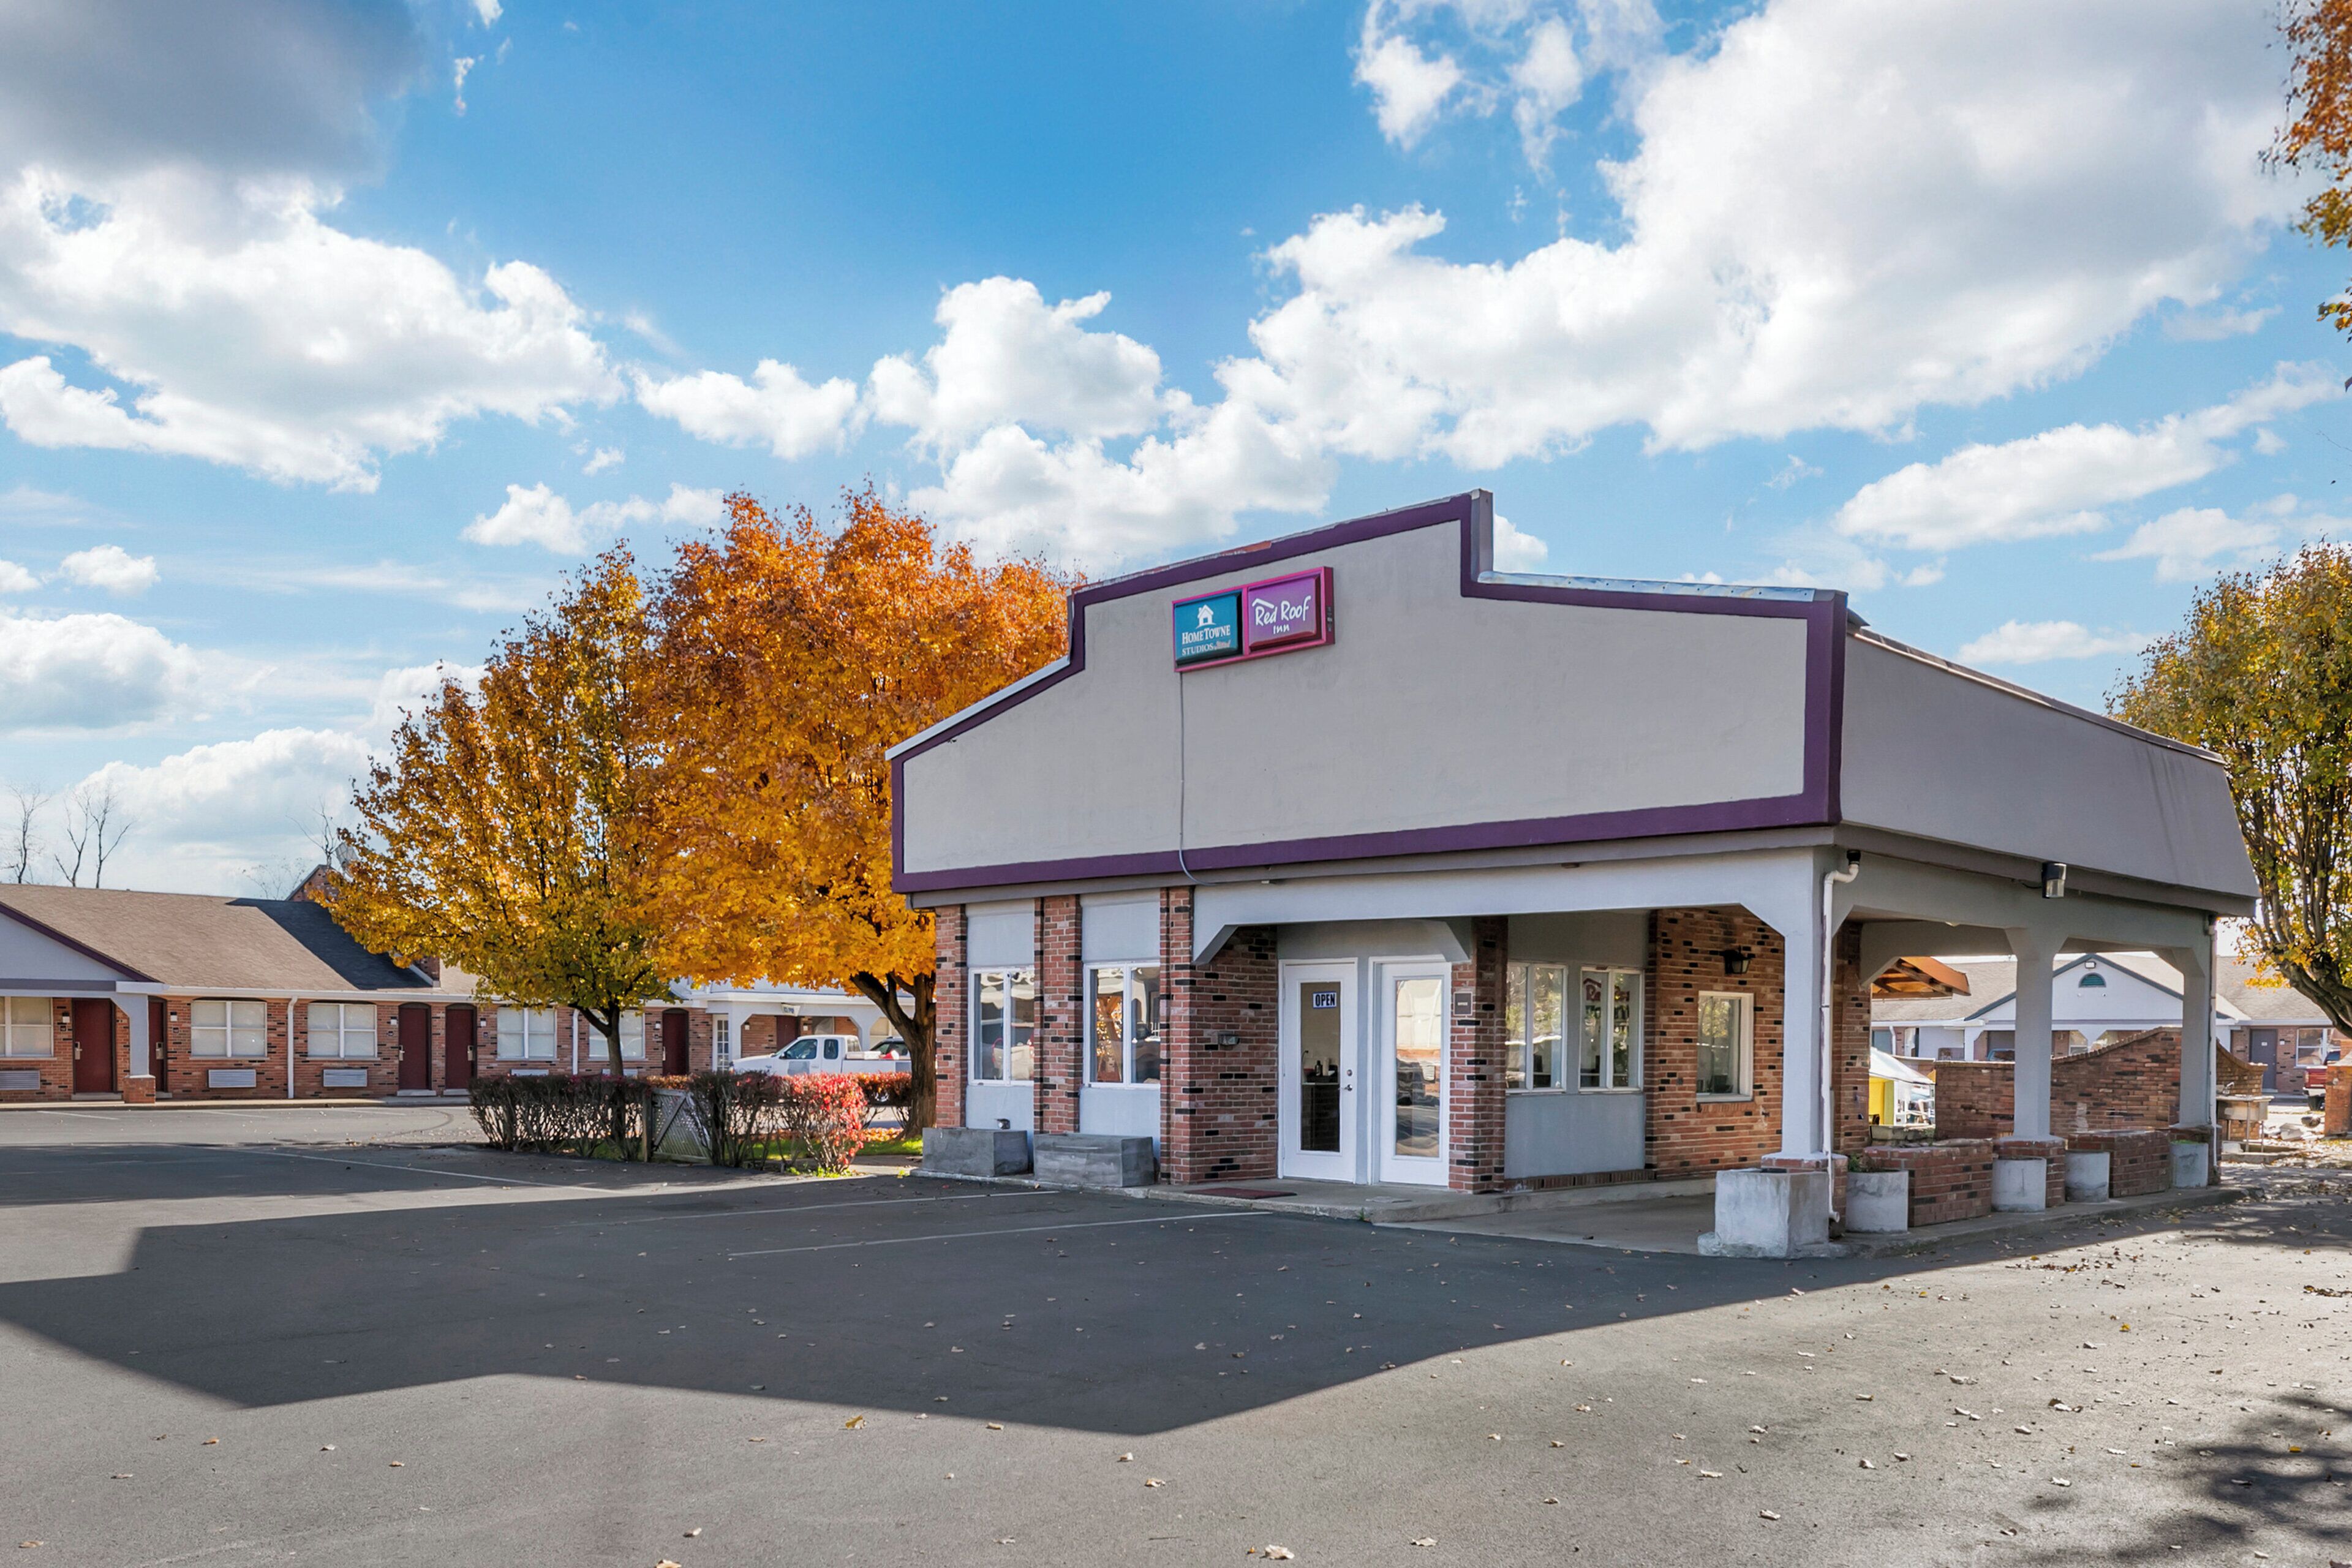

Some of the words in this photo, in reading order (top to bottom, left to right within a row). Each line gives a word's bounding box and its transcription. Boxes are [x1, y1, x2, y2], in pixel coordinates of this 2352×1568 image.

[1255, 606, 1278, 626] Red
[1281, 595, 1311, 622] Roof
[1182, 643, 1214, 656] STUDIOS
[1315, 993, 1335, 1006] OPEN
